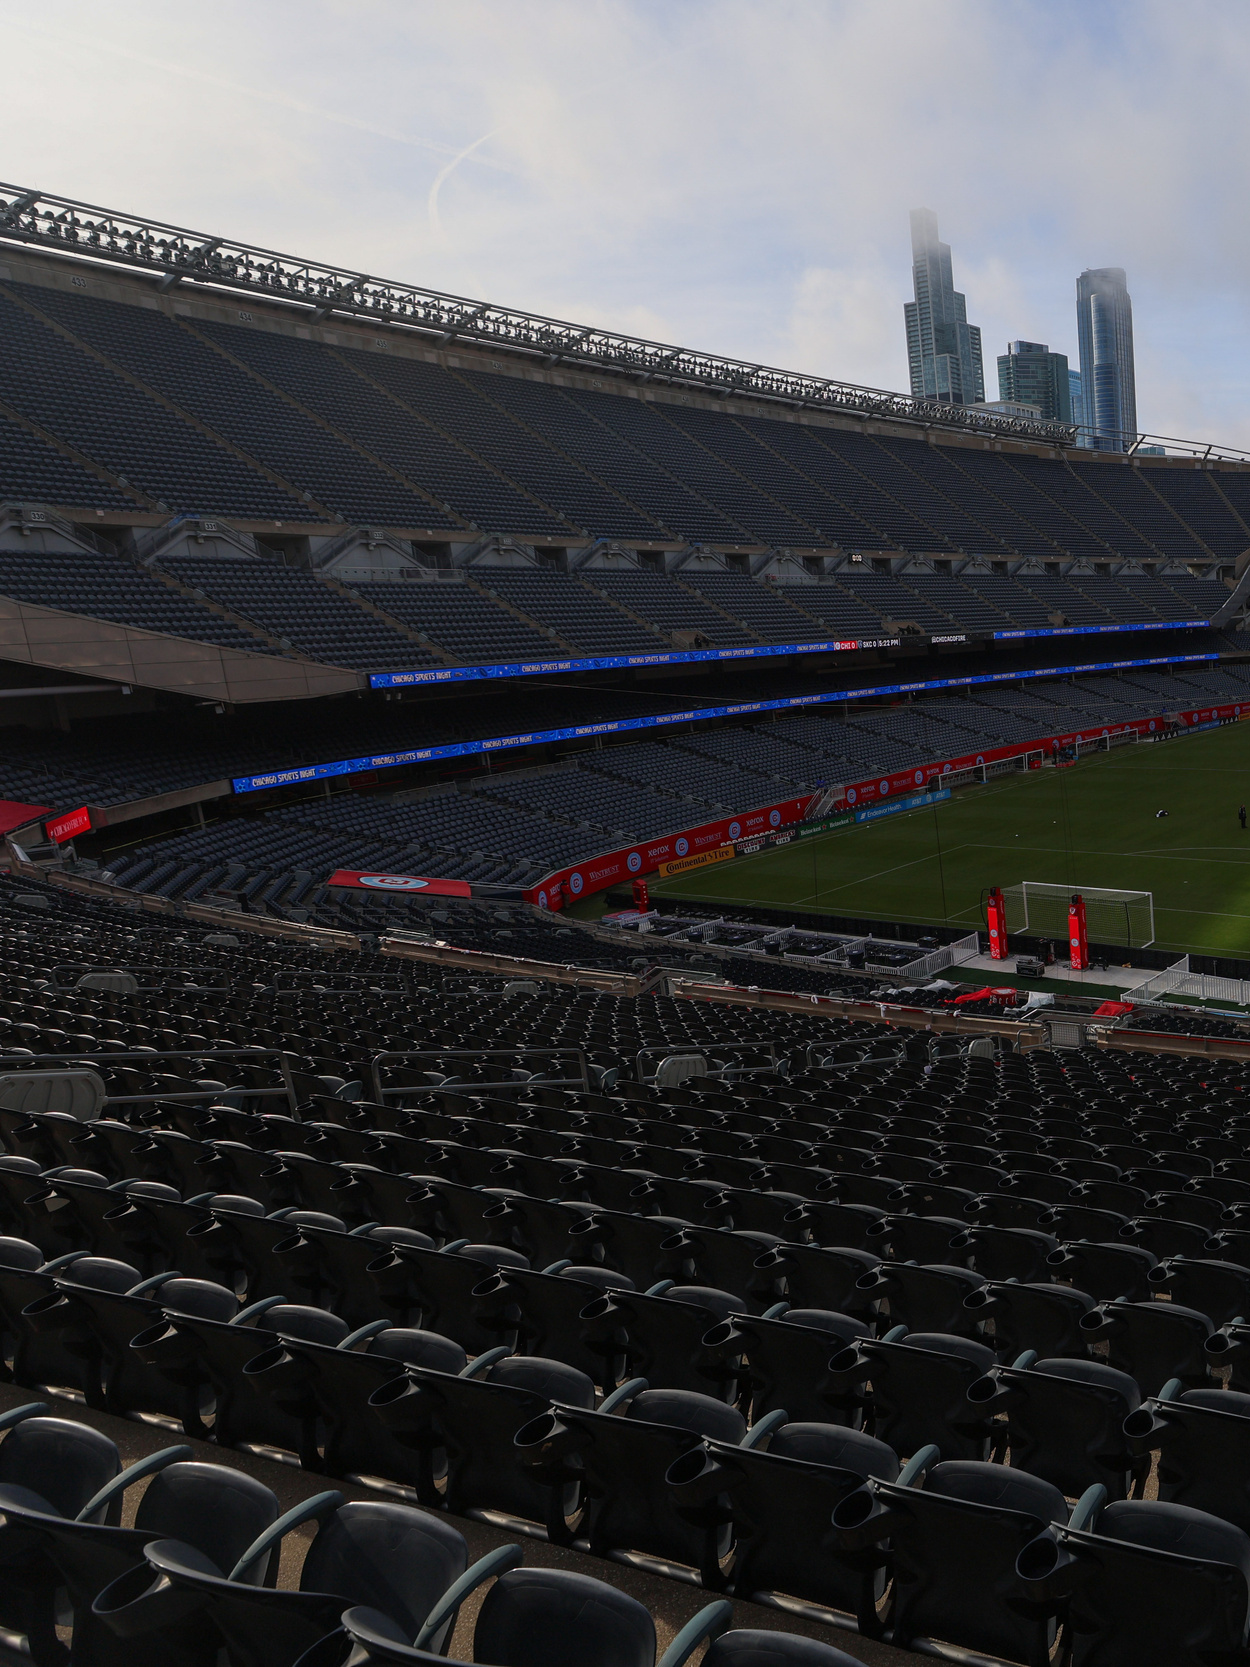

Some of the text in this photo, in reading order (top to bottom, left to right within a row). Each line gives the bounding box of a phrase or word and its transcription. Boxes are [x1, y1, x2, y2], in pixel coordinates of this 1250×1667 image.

[931, 635, 966, 643] @CHICAGOFIRE
[522, 665, 541, 673] CHICAGO
[541, 663, 558, 671] SPORTS
[392, 674, 414, 683] CHICAGO
[415, 673, 435, 681] SPORTS
[482, 740, 502, 748] CHICAGO
[502, 738, 518, 746] SPORTS
[372, 750, 432, 766] CHICAGO SPORTS NIGHT
[252, 768, 315, 787] CHICAGO SPORTS NIGHT
[861, 785, 875, 794] xerox
[867, 807, 888, 818] Endeavor
[746, 815, 764, 826] xerox
[829, 819, 849, 828] Heineken
[800, 827, 822, 836] Heineken
[694, 832, 722, 847] WINTRUST
[737, 838, 765, 850] DISCOUNT
[648, 844, 669, 857] xerox
[666, 849, 729, 873] Continental Tire
[589, 865, 619, 880] WINTRUST
